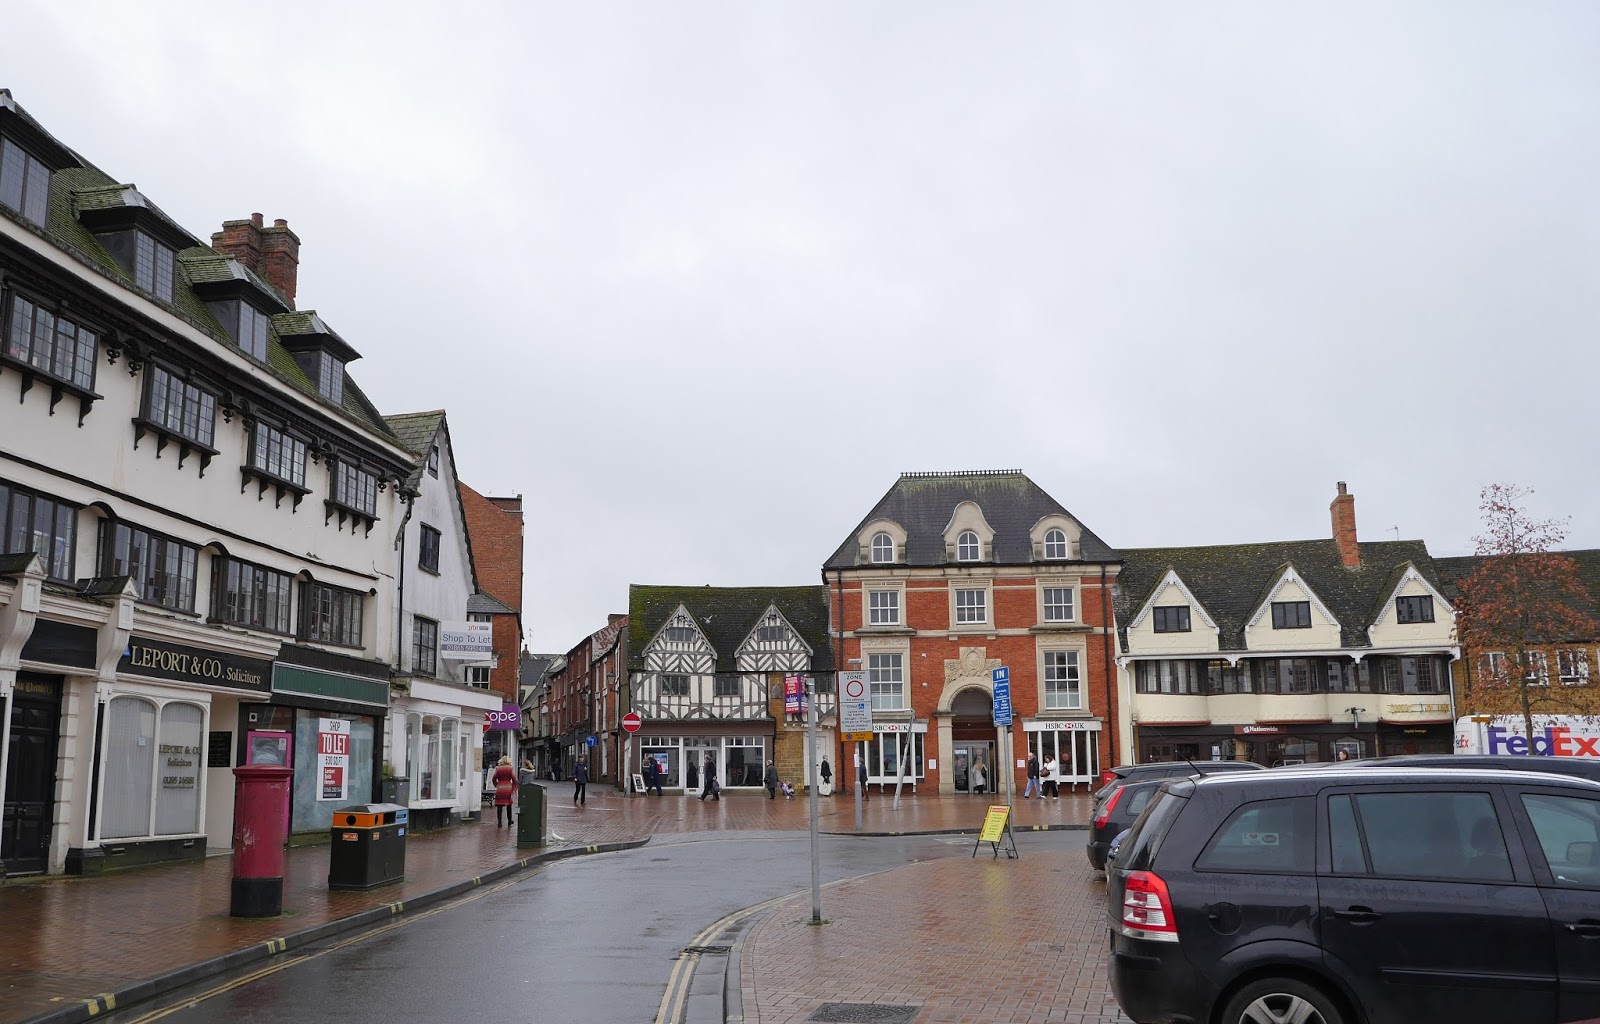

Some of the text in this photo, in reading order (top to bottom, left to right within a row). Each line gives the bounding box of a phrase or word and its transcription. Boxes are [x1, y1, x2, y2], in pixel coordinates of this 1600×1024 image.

[442, 633, 491, 644] Shop To Let
[130, 645, 189, 673] LEPORT
[190, 656, 201, 676] &
[226, 667, 261, 685] Solicitors
[996, 669, 1005, 680] IN
[489, 712, 517, 724] ope
[330, 720, 341, 732] SHOP
[322, 733, 347, 754] TO LET
[1487, 727, 1600, 757] FedEx
[159, 744, 184, 754] LEPORT
[185, 746, 191, 755] &
[167, 757, 192, 767] Solicitors
